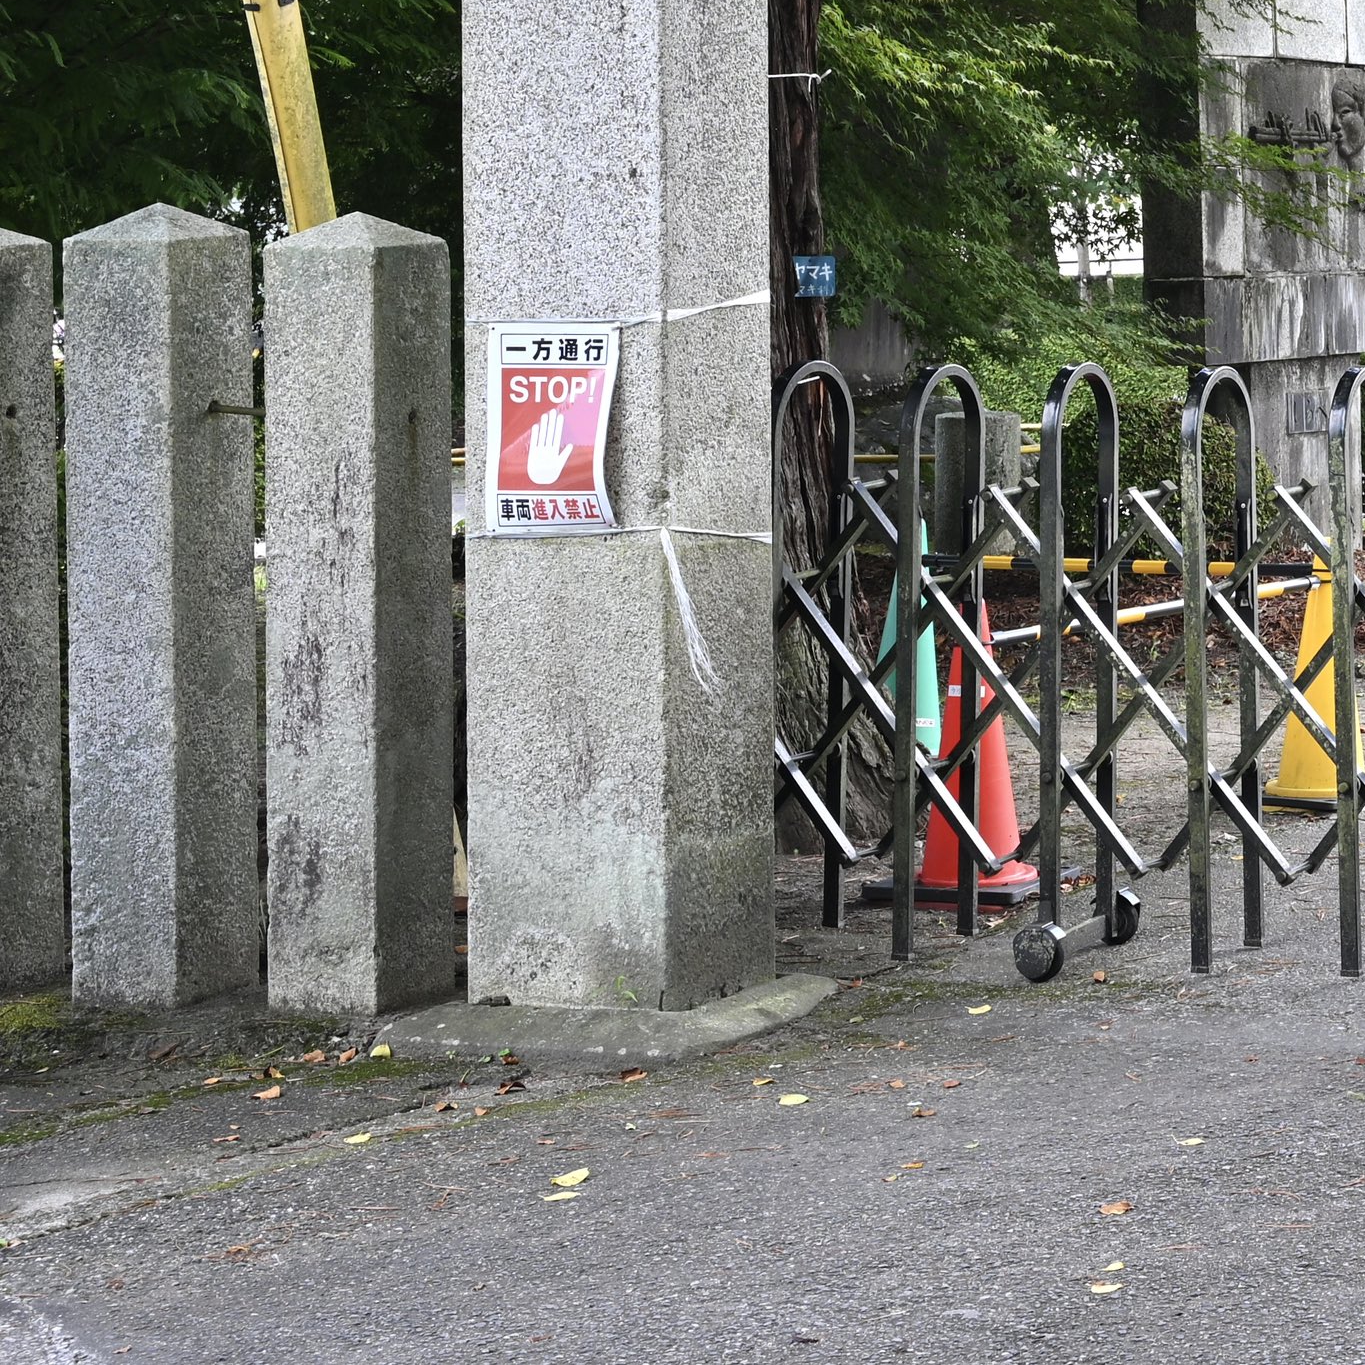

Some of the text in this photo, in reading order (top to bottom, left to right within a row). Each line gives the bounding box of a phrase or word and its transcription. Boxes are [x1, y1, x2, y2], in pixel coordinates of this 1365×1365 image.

[506, 337, 604, 362] 一方通行
[509, 374, 597, 404] STOP!
[500, 497, 601, 522] 車両進入禁止
